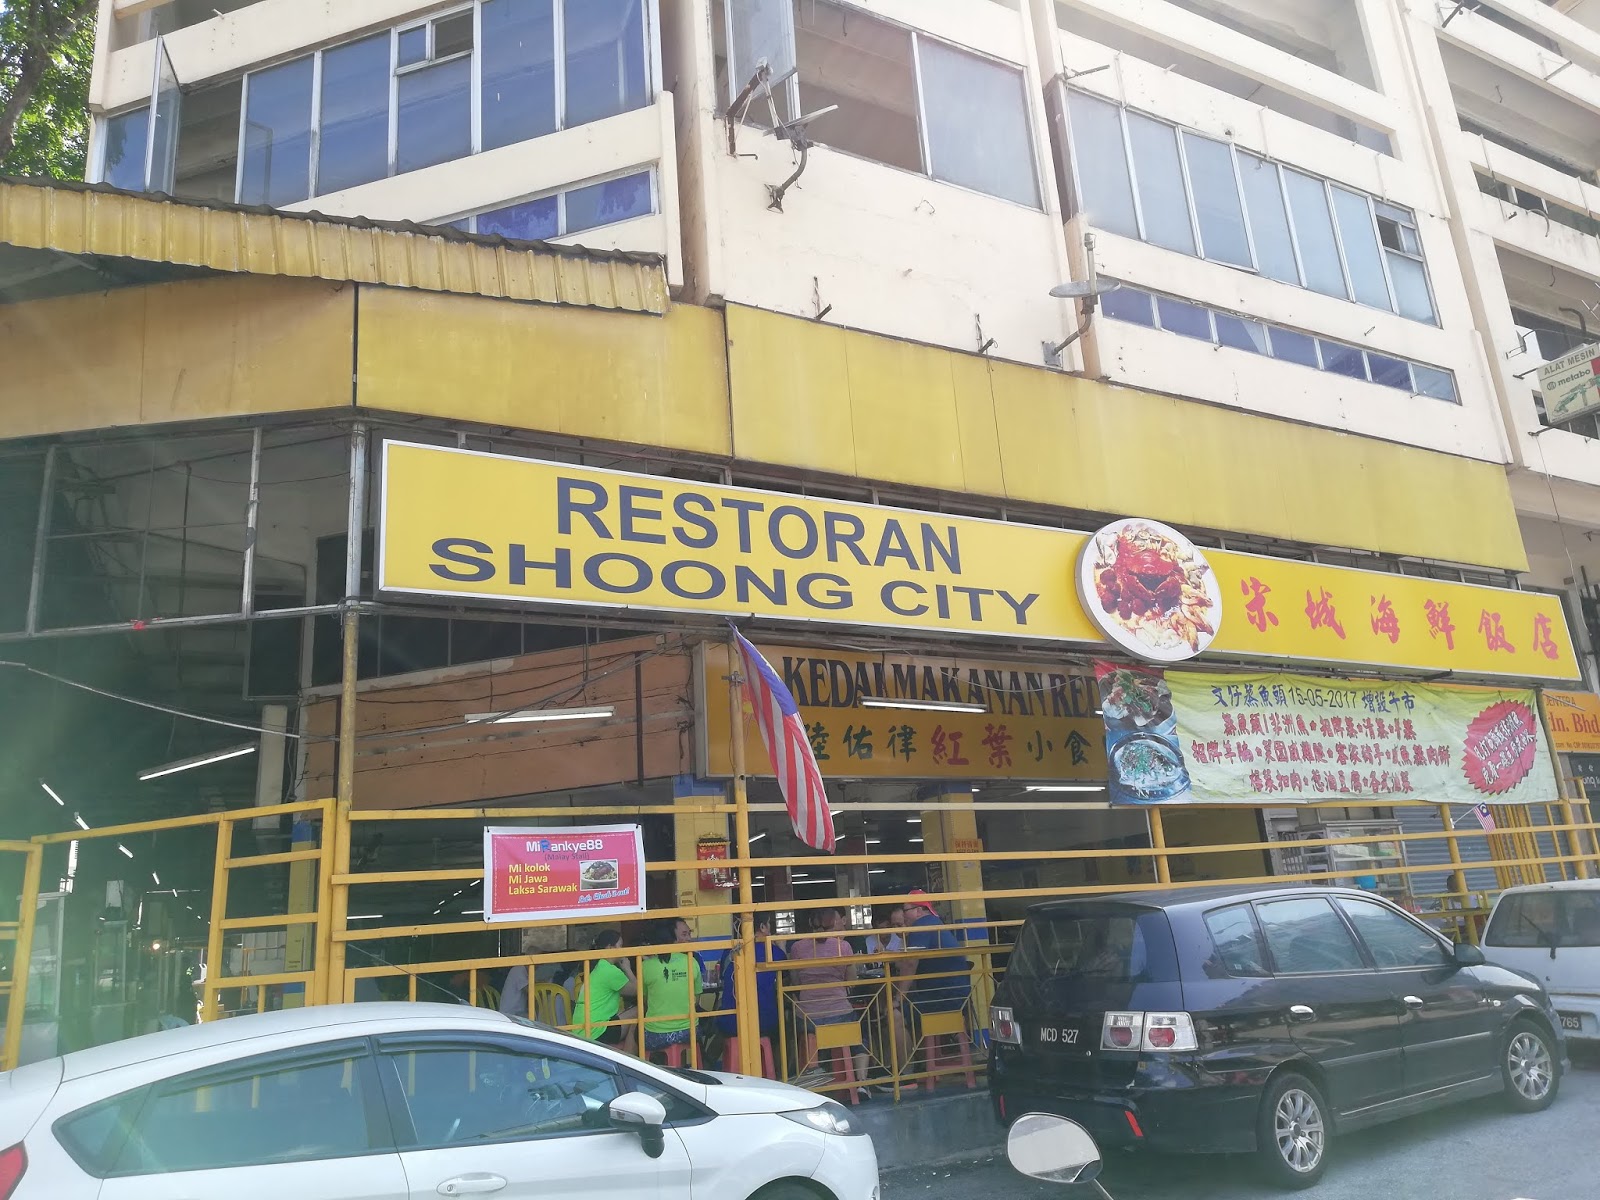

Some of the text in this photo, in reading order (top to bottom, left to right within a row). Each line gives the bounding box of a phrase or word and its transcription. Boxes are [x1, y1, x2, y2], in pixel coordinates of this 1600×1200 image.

[1544, 348, 1595, 375] ALAT MESIN
[1558, 369, 1591, 386] metabo
[556, 476, 962, 574] RESTORAN
[428, 537, 1040, 625] SHOONG CITY
[1240, 576, 1560, 660] 宋城海鮮飯店
[782, 656, 885, 709] KEDAI
[891, 663, 1047, 716] MAKANAN
[1288, 688, 1357, 709] 15-05-2017
[804, 720, 1107, 768] 陸佑律紅葉小食
[508, 862, 550, 873] Mi kolok
[508, 874, 548, 884] Mi Jawa
[508, 884, 578, 895] Laksa Sarawak
[1560, 1016, 1579, 1028] 765
[1040, 1027, 1079, 1044] MCD 527
